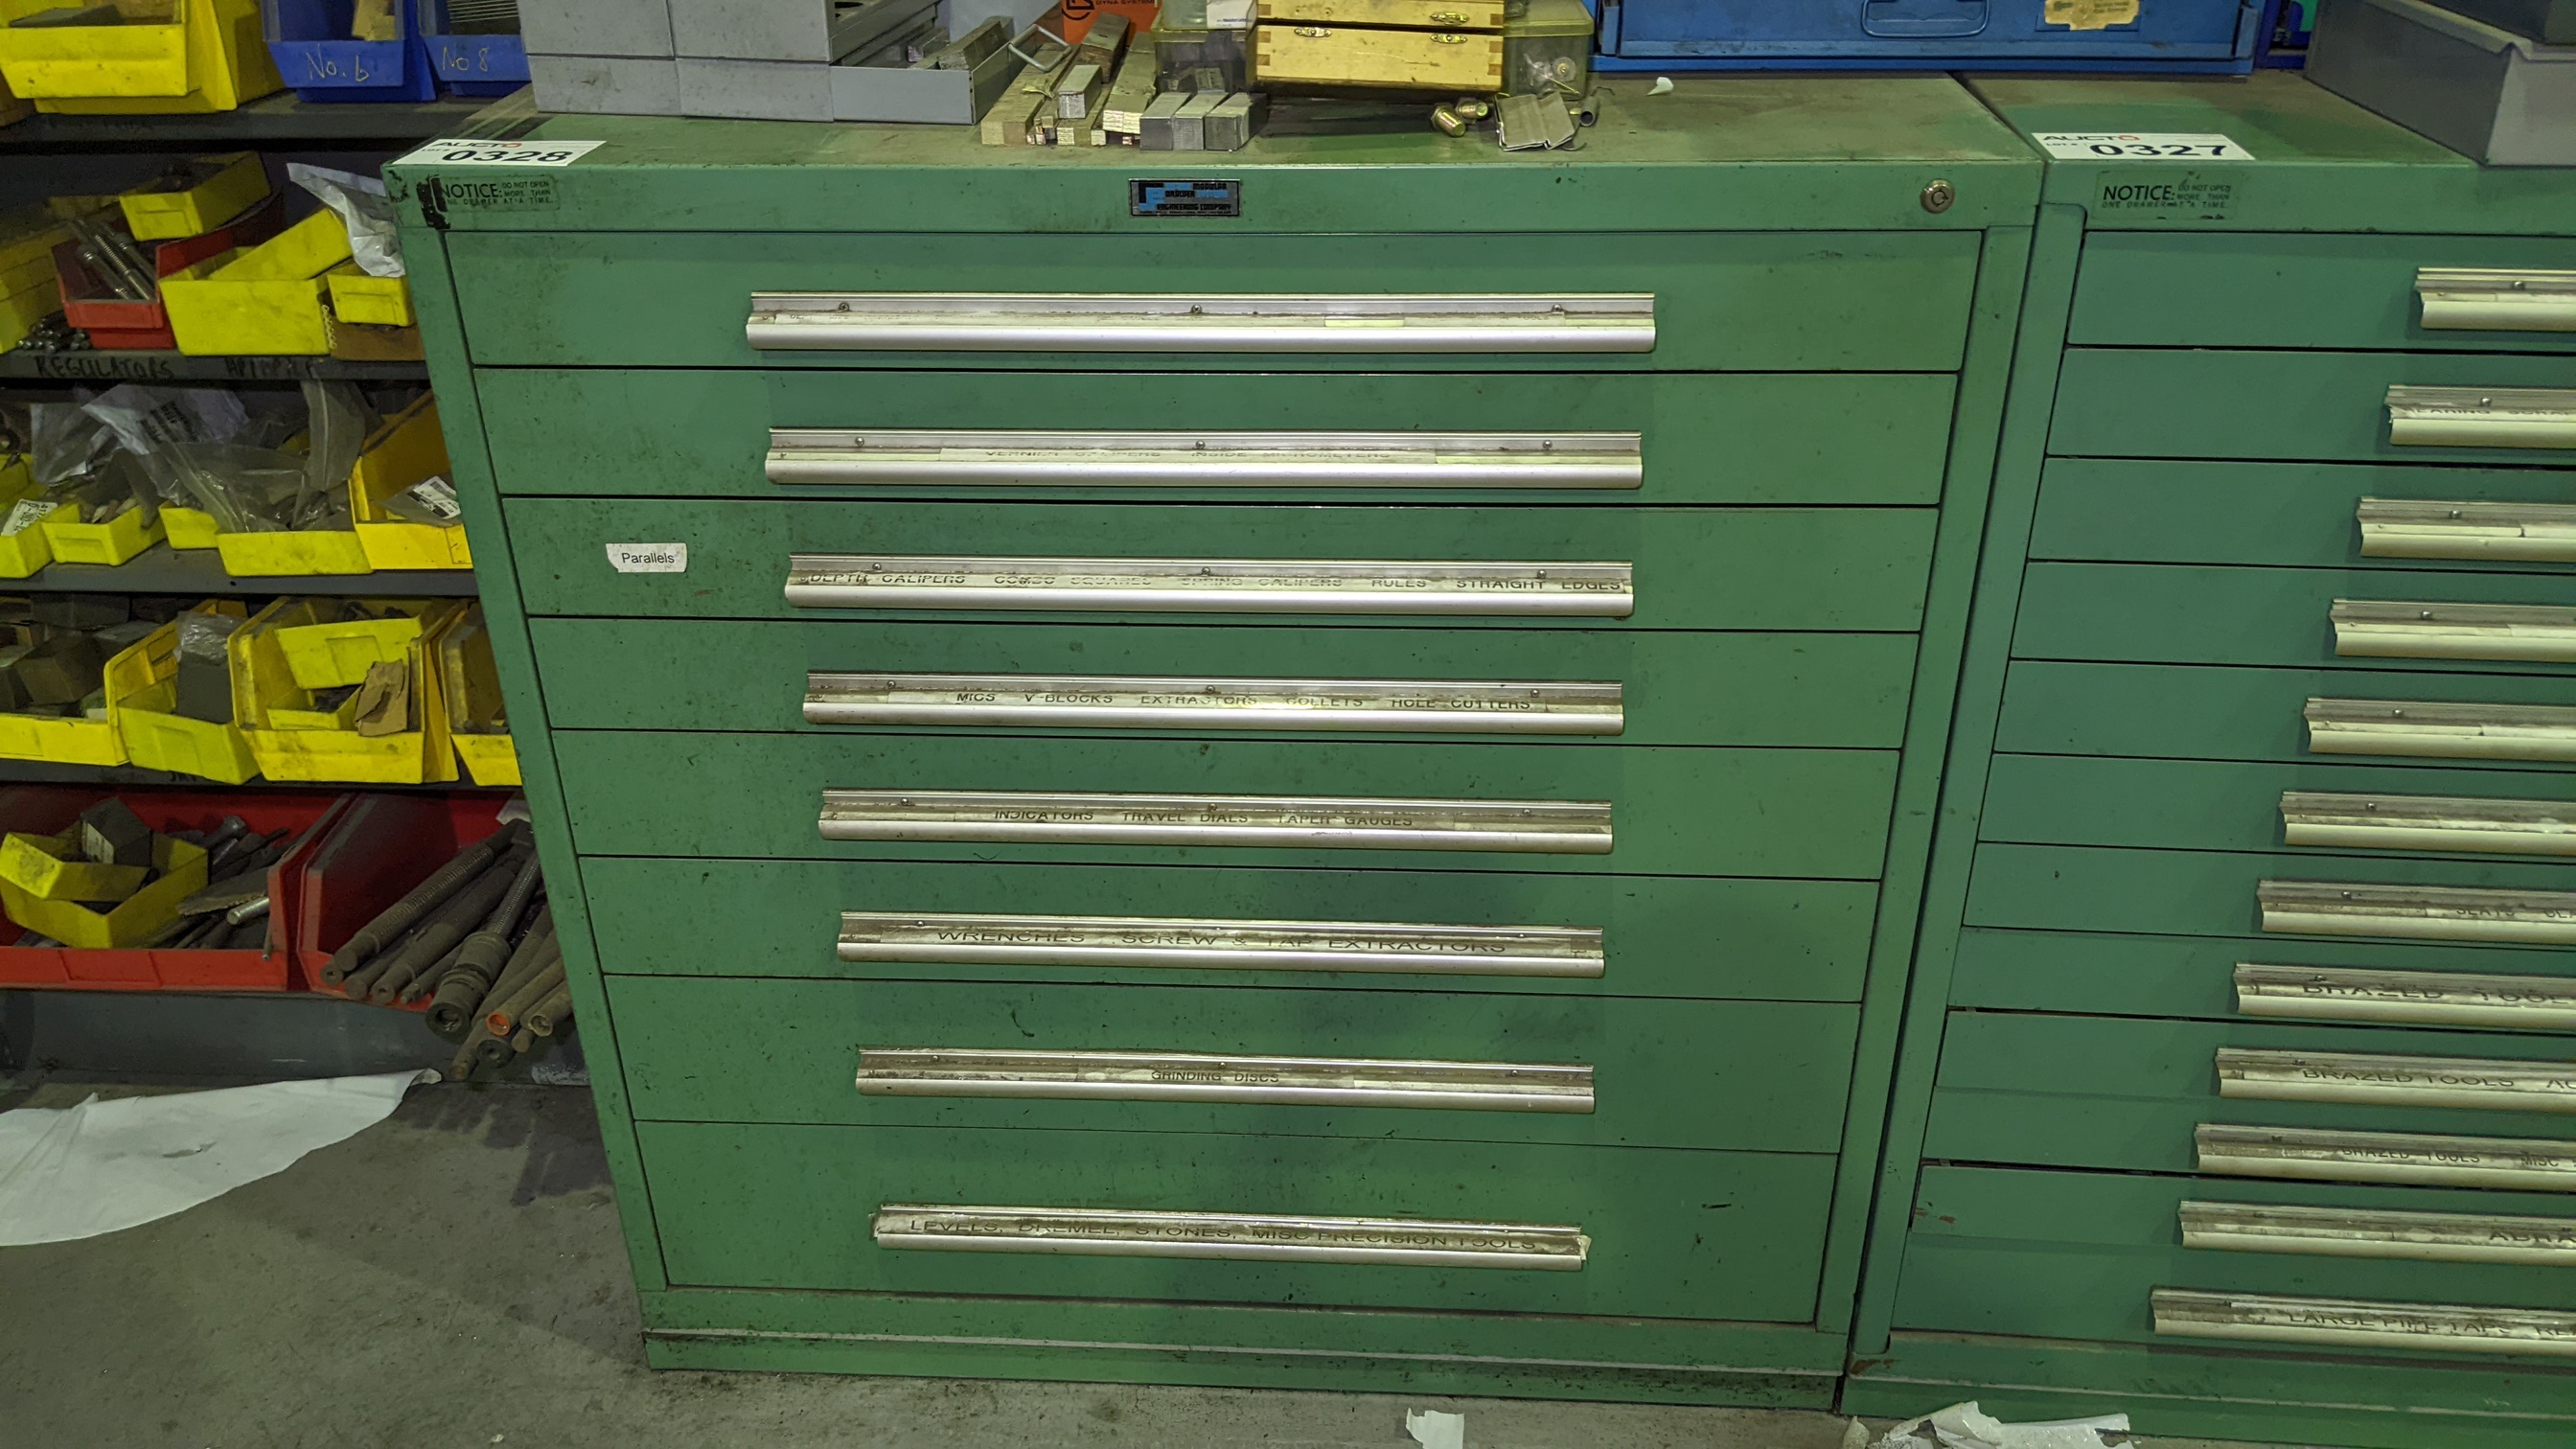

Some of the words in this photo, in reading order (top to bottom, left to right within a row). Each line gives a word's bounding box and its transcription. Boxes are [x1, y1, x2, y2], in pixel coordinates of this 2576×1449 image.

[441, 150, 574, 162] 0328
[2089, 144, 2227, 156] 0327
[443, 183, 503, 198] NOTICE:
[2103, 185, 2175, 200] NOTICE:
[621, 552, 676, 564] Parallels
[810, 573, 868, 583] DEPTH
[881, 574, 966, 585] CALIPERS
[1070, 576, 1152, 586] SQUARES
[1257, 577, 1343, 586] CALIPERS
[1370, 578, 1428, 588] RULES
[1456, 580, 1548, 589] STRAIGHT
[1561, 581, 1622, 590] EDGES
[956, 692, 996, 702] MICS
[1140, 695, 1258, 706] EXTRACTORS
[1285, 696, 1364, 707] COLLETS
[1391, 698, 1436, 708] HOLE
[1450, 699, 1531, 710] CUTTERS
[994, 810, 1094, 821] INDICATORS
[1121, 811, 1186, 822] TRAVEL
[1200, 813, 1248, 823] DIALS
[1277, 815, 1331, 825] TAPER
[1344, 816, 1413, 826] GAUGES
[937, 932, 1085, 943] WRENCHES
[1121, 933, 1218, 945] SCREW
[1266, 937, 1313, 948] TAP
[1328, 938, 1506, 954] EXTRACTORS
[2472, 987, 2576, 1004] TOOL
[1151, 1070, 1222, 1081] GRINDING
[1233, 1071, 1279, 1083] DISCS
[2302, 1069, 2413, 1083] BRAZED
[2426, 1071, 2515, 1088] TOOLS
[2425, 1149, 2480, 1163] TOOLS
[1251, 1229, 1310, 1240] MISC
[1318, 1231, 1447, 1246] PRECISION
[1458, 1236, 1536, 1250] TOOLS
